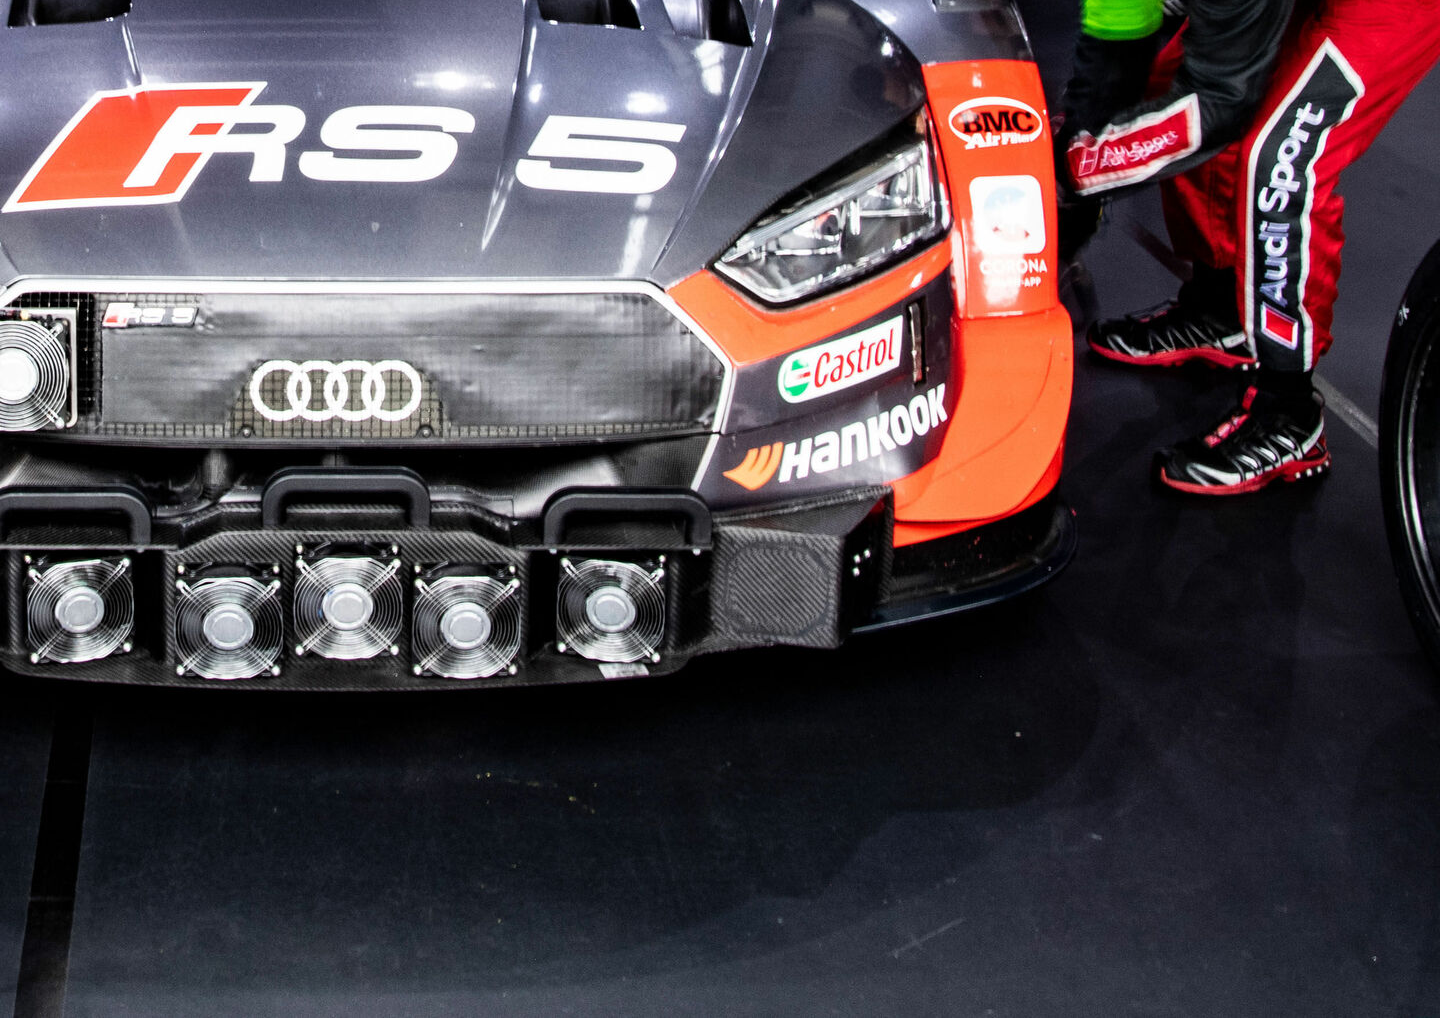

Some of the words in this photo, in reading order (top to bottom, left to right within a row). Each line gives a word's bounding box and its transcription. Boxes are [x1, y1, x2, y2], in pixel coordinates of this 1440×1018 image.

[122, 104, 476, 188] RS
[515, 115, 687, 195] 5
[962, 111, 1034, 133] BMC
[1258, 101, 1325, 212] Sport
[979, 258, 1048, 274] CONA
[1259, 220, 1290, 307] Audi
[814, 328, 895, 388] Castrol
